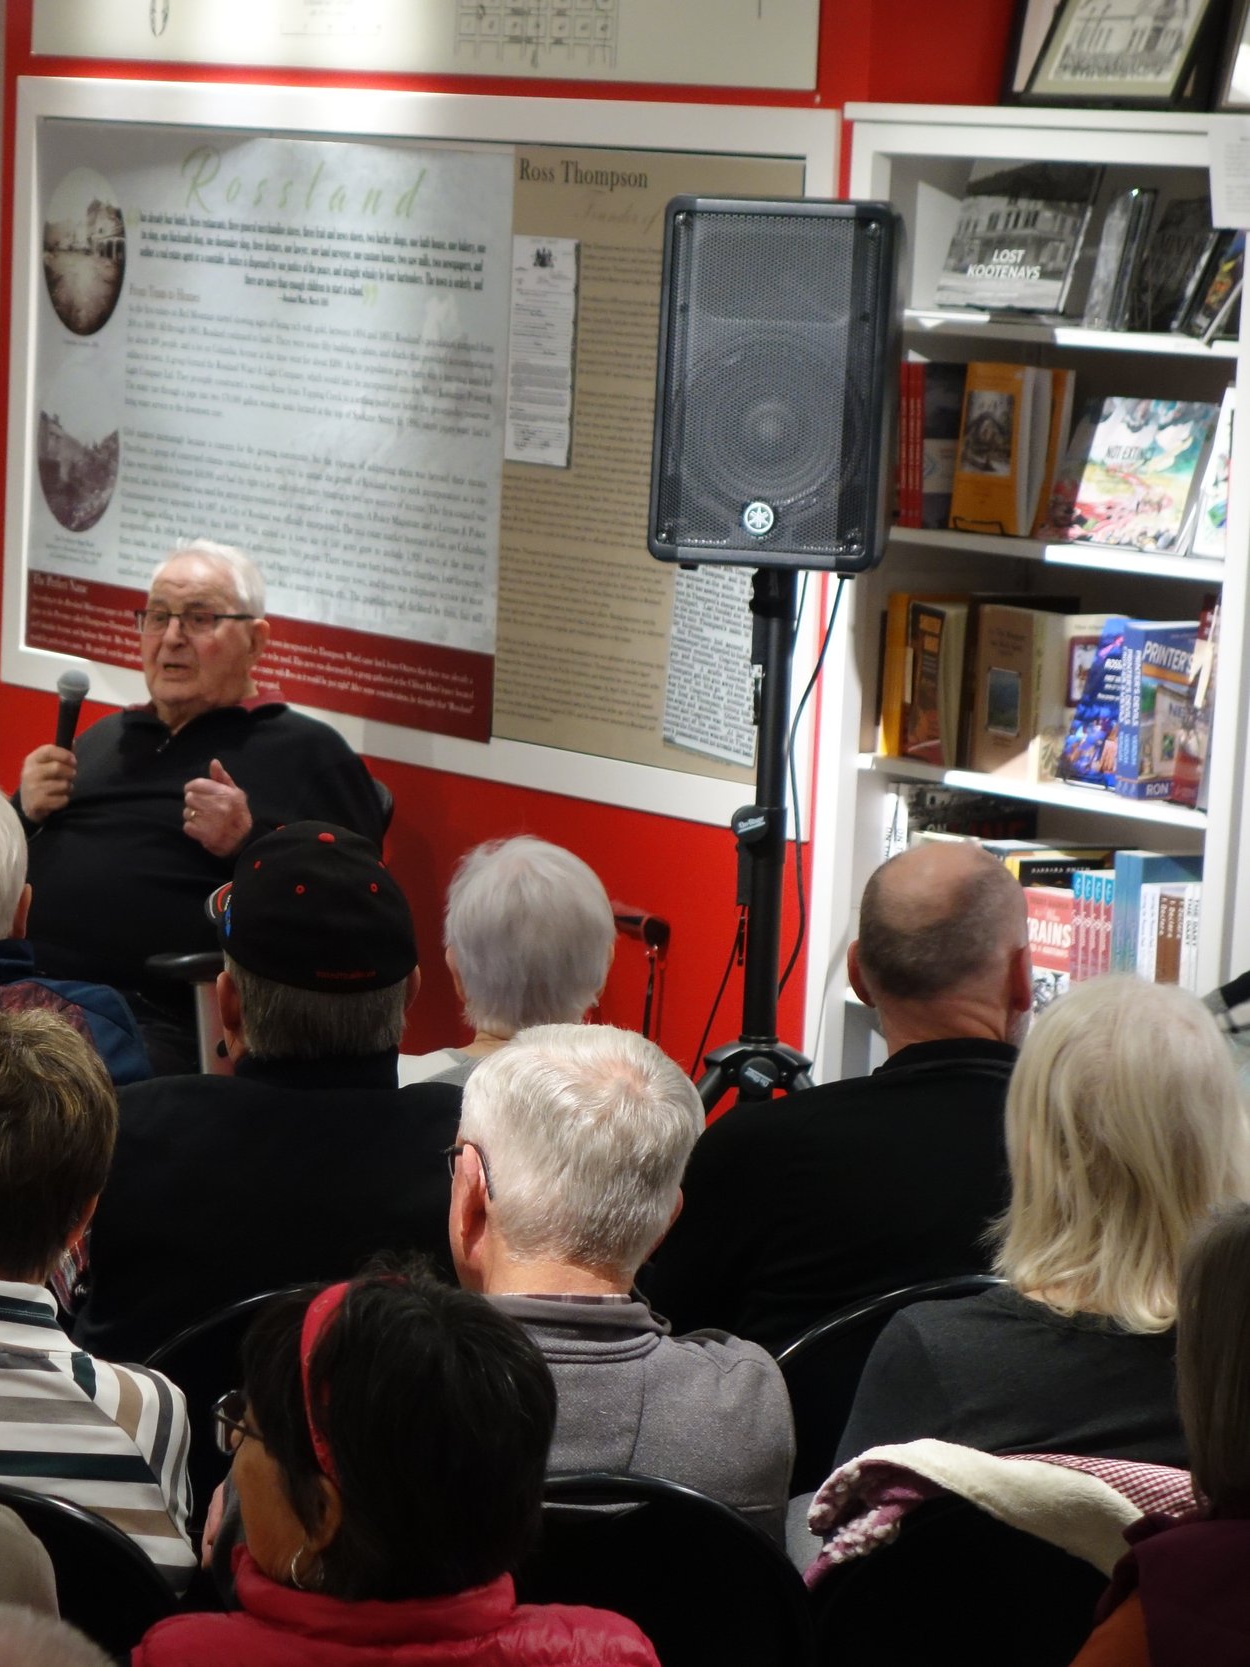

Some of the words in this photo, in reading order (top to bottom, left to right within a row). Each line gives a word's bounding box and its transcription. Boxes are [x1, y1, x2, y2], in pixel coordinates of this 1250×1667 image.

[181, 146, 428, 219] Rossland
[519, 157, 555, 182] Ross
[561, 159, 648, 193] Thompson
[993, 249, 1026, 263] LOST
[966, 264, 1041, 280] KOOTENAYS
[1146, 782, 1169, 797] RON
[1027, 917, 1071, 949] RAINS
